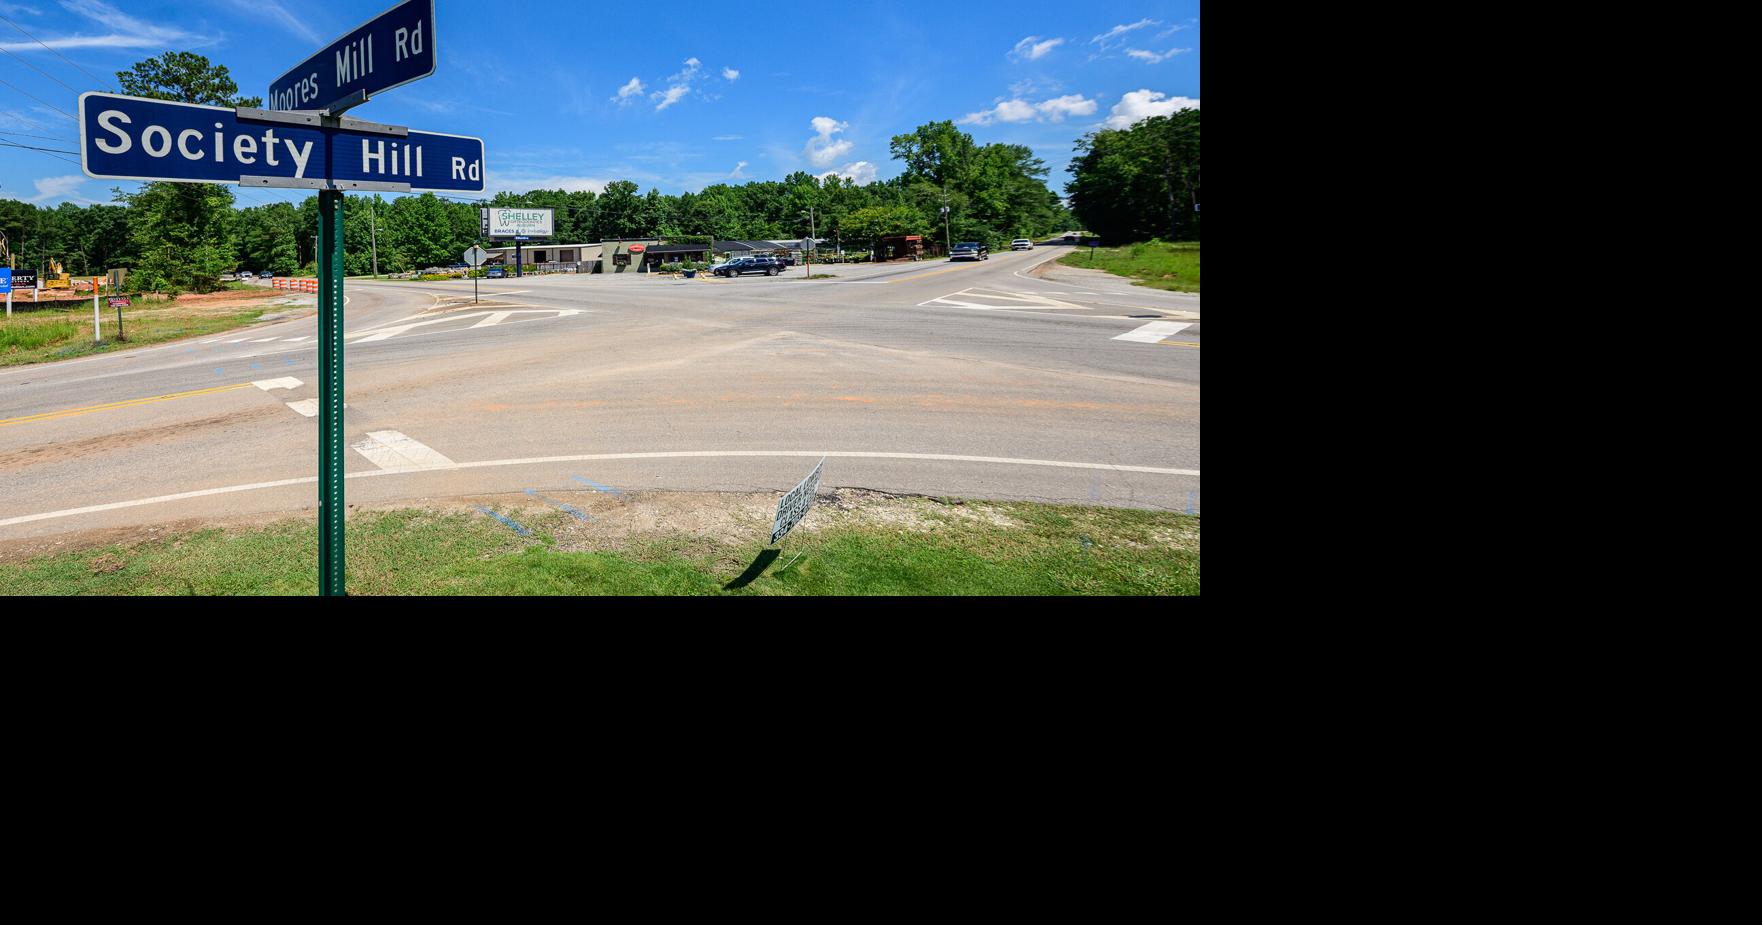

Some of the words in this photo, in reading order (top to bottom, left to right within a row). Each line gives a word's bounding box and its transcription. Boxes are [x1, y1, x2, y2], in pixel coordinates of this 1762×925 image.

[270, 72, 318, 110] Moores
[336, 33, 374, 88] Mill
[395, 19, 423, 62] Rd
[95, 110, 314, 178] Society
[361, 138, 423, 177] Hill
[451, 156, 480, 182] Rd
[502, 212, 544, 221] SHELLEY
